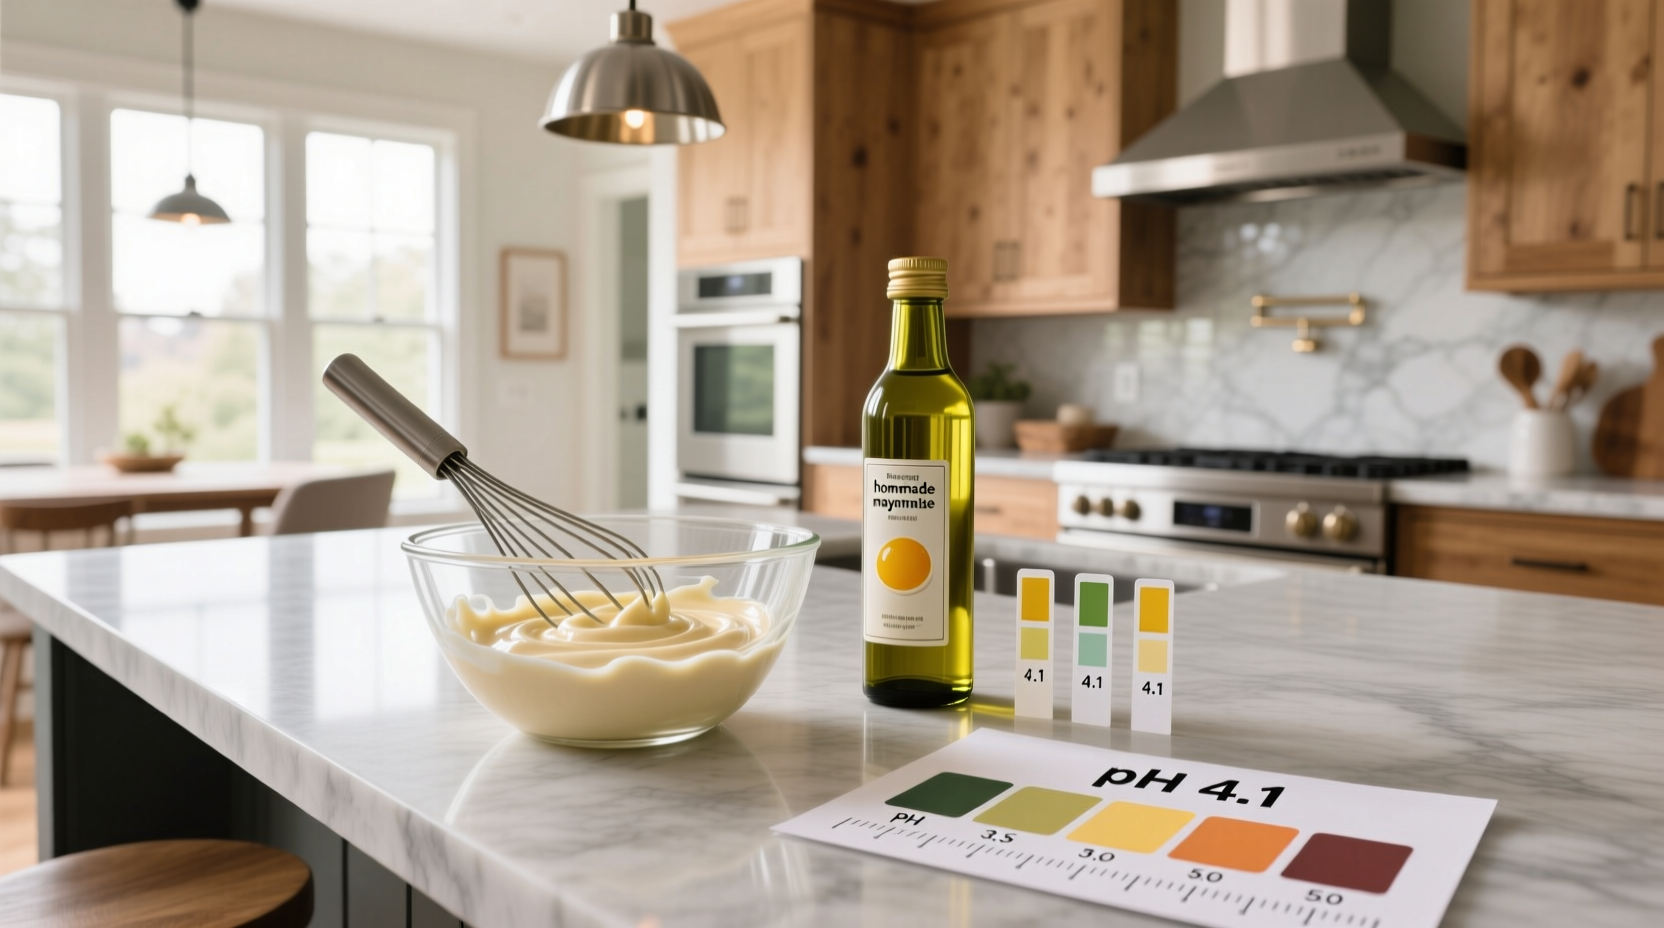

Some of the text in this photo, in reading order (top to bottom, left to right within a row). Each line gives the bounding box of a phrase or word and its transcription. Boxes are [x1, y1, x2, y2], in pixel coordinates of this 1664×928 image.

[874, 479, 936, 495] hommade
[1024, 668, 1044, 682] 4.1
[1081, 675, 1102, 689] 4.1
[1142, 681, 1163, 695] 4.1
[1091, 767, 1286, 808] pH 4.1
[981, 829, 1017, 843] 3.5
